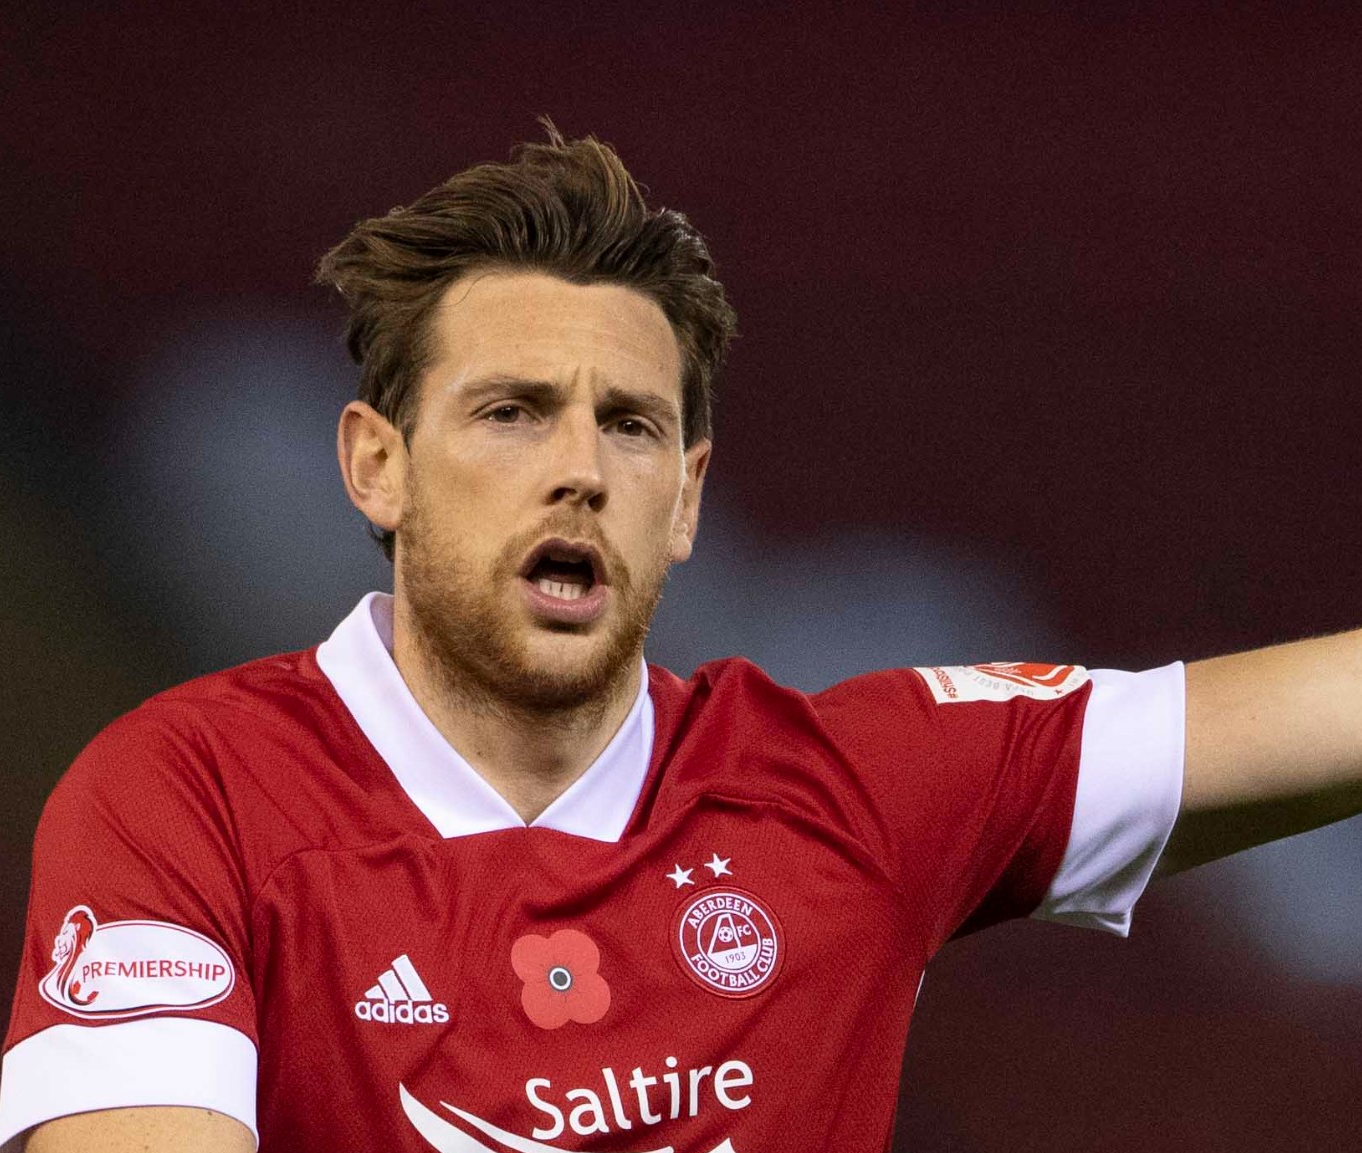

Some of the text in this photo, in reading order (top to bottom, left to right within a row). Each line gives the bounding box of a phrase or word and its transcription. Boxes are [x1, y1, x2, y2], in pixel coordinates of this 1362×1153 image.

[687, 897, 753, 929] ABERDEEN
[82, 960, 225, 982] PREMIERSHIP
[691, 938, 774, 987] FOOTBALL CLUB
[724, 951, 746, 964] 1903
[354, 1000, 450, 1024] adidas
[525, 1056, 754, 1140] Saltire
